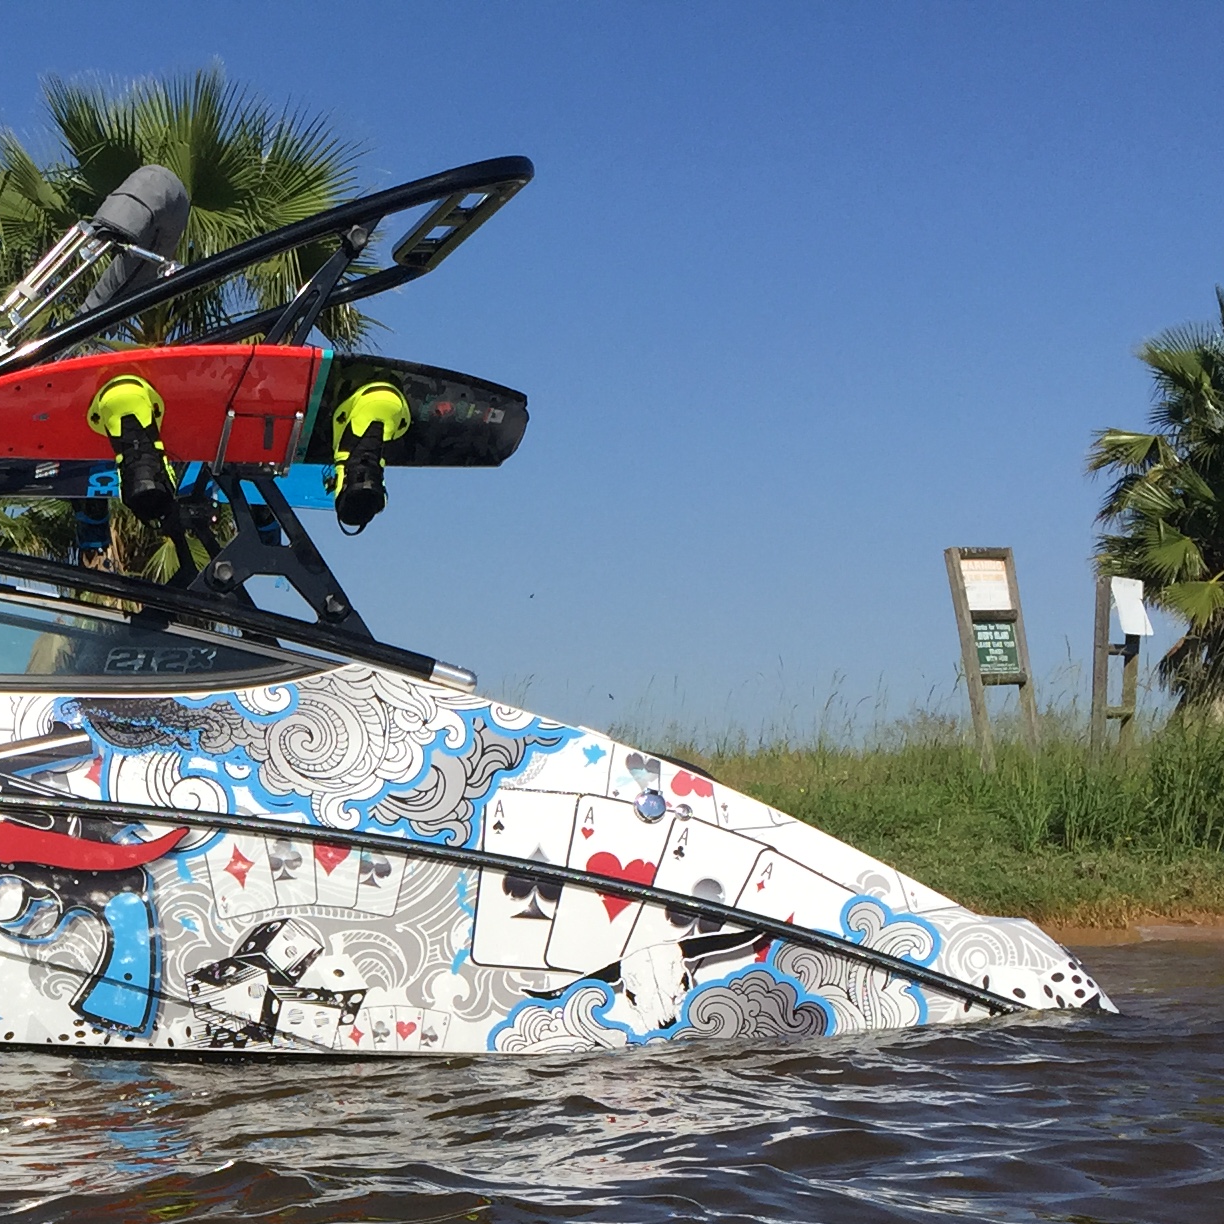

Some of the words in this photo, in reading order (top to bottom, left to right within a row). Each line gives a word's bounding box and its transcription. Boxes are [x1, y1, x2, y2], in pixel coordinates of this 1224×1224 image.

[105, 647, 217, 674] 212X
[494, 799, 505, 818] A
[583, 806, 594, 825] A
[677, 827, 689, 846] A
[761, 862, 774, 880] A
